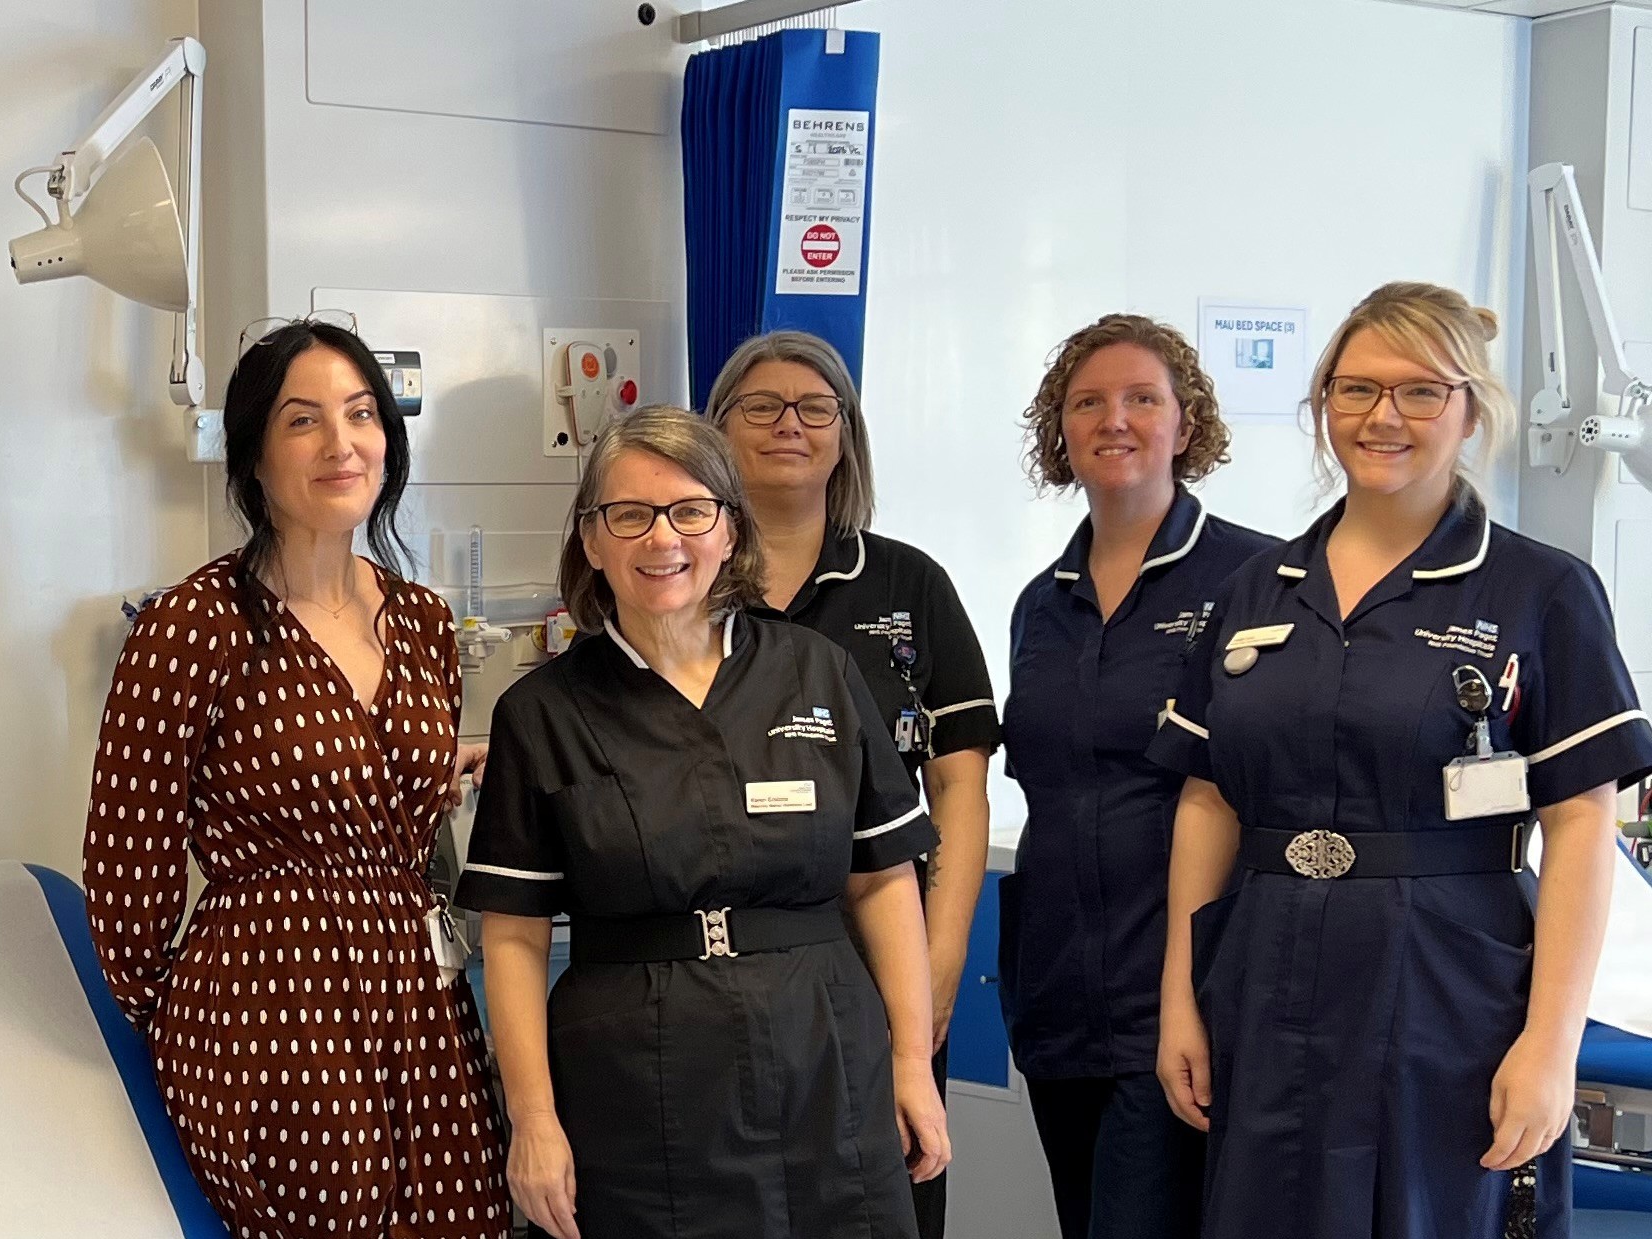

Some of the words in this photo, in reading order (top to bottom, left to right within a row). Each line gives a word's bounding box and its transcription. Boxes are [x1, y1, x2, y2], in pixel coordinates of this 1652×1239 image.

[793, 120, 865, 132] BEHRENS
[785, 214, 817, 223] RESPECT
[830, 215, 861, 224] PRIVACY
[806, 231, 819, 240] DO
[819, 231, 836, 240] NOT
[807, 252, 833, 260] ENTER
[1215, 319, 1234, 331] MAU
[1236, 319, 1254, 331] BED
[1254, 320, 1283, 332] SPACE
[1414, 628, 1457, 642] University
[768, 724, 806, 737] University
[805, 725, 836, 736] Hospitals
